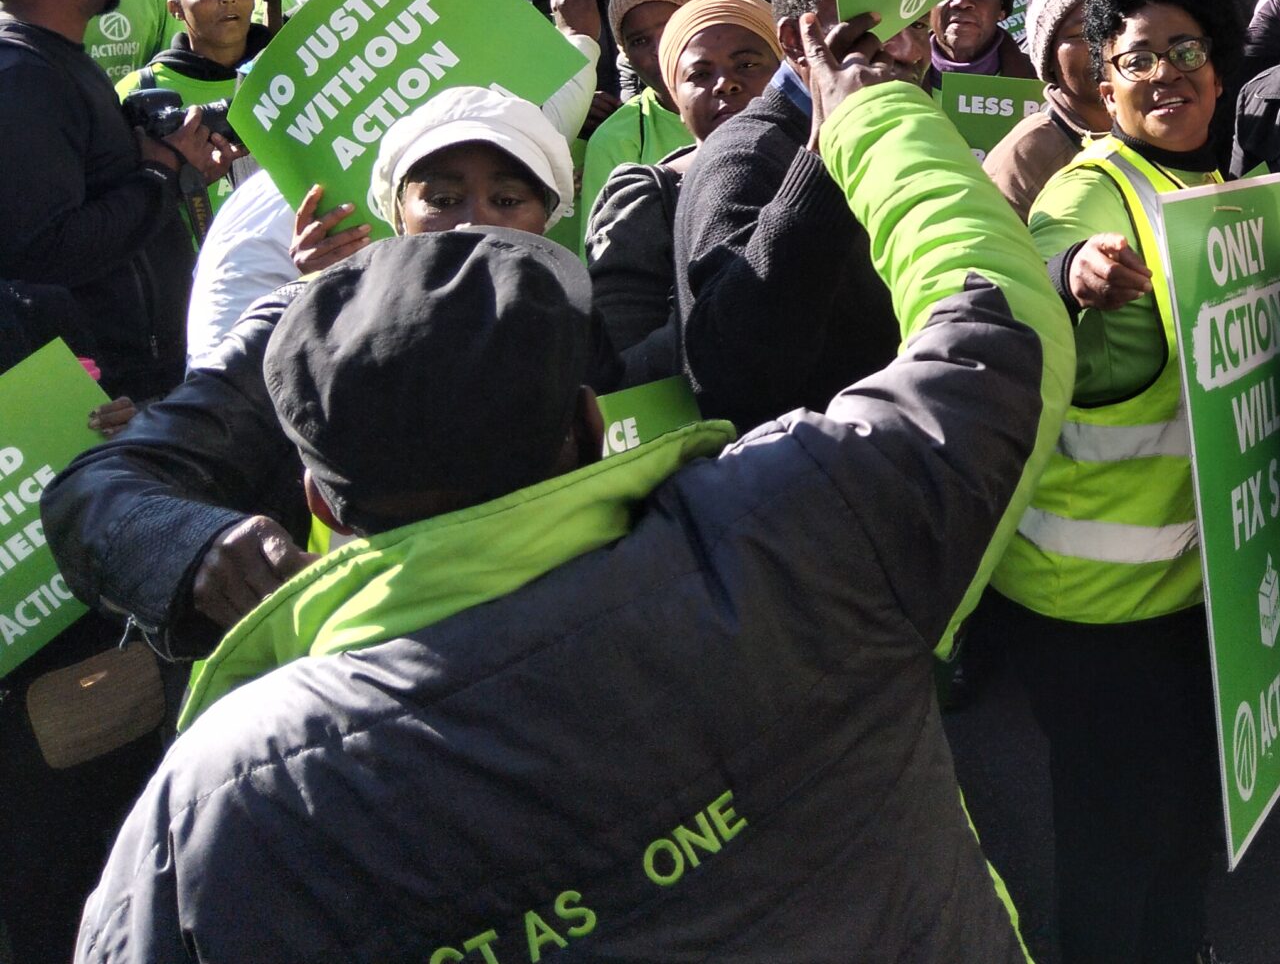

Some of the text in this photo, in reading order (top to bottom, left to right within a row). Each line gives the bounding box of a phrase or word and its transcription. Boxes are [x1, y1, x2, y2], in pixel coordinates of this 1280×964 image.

[252, 74, 295, 132] NO
[331, 40, 460, 171] ACTION
[958, 94, 1014, 117] LESS
[1207, 217, 1264, 286] ONLY
[1232, 377, 1280, 454] WILL
[0, 464, 57, 526] TICE
[1231, 470, 1266, 551] FIX
[0, 573, 74, 647] ACTIO
[524, 890, 597, 963] AS
[643, 789, 748, 887] ONE
